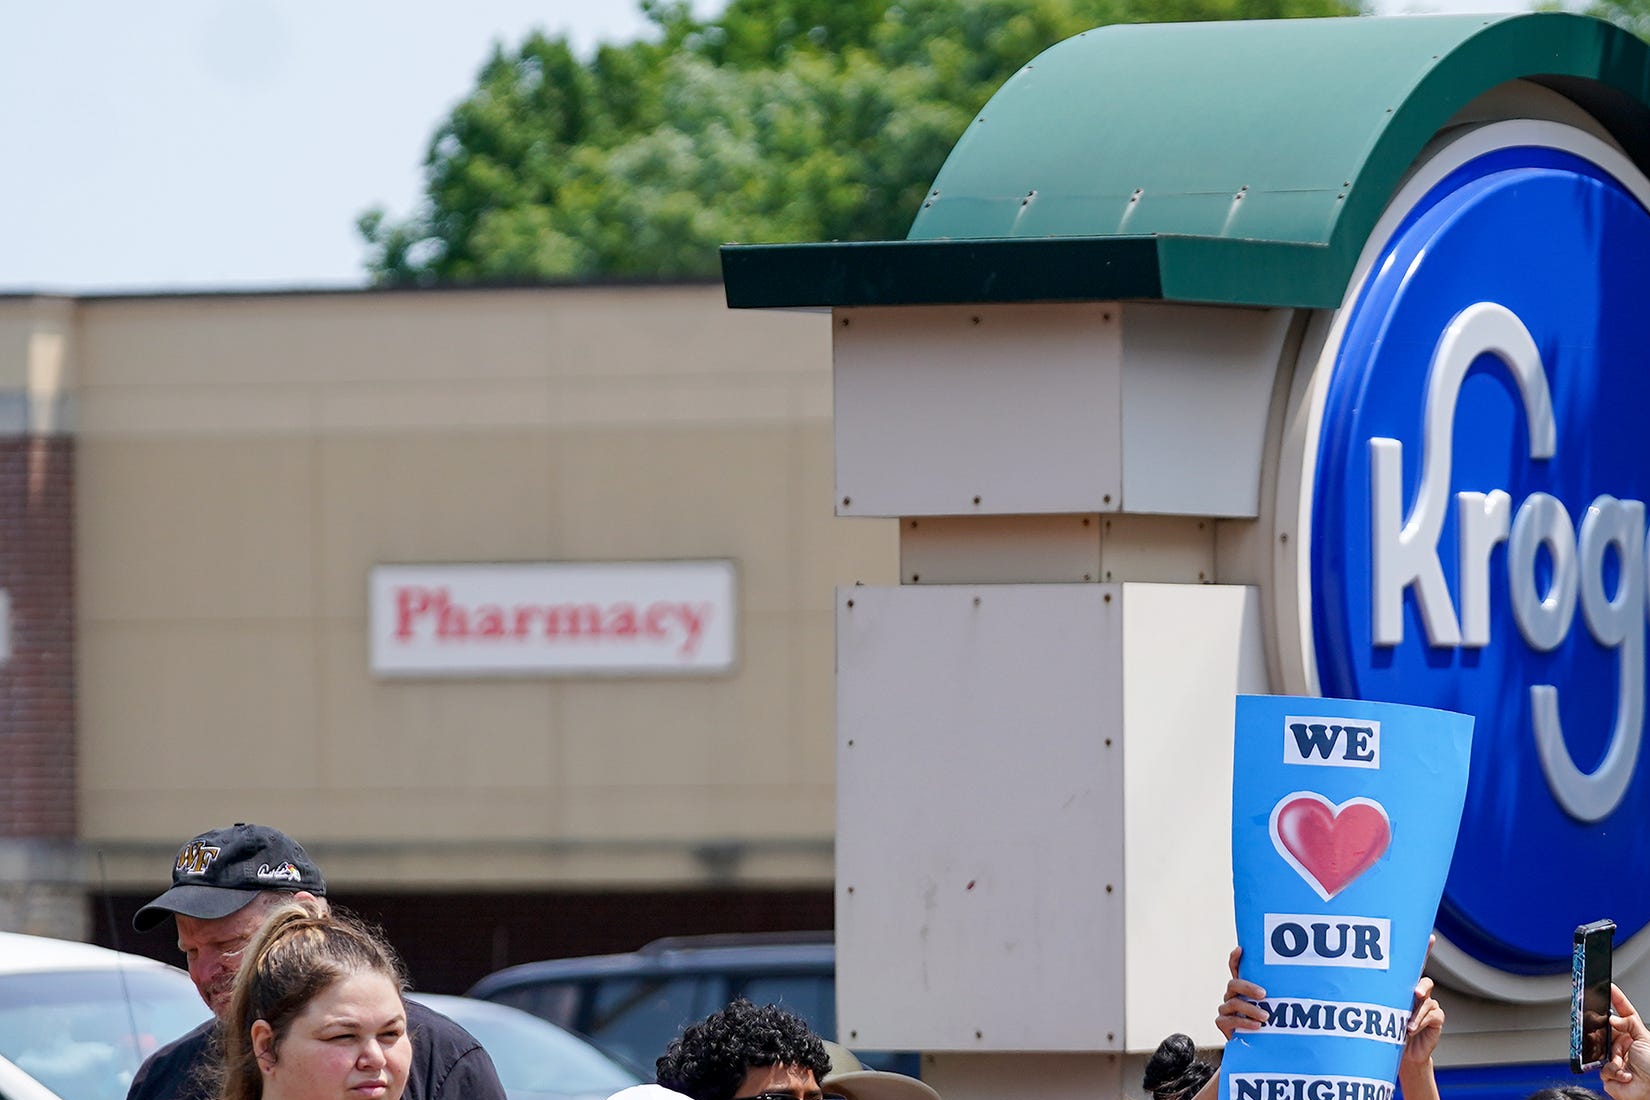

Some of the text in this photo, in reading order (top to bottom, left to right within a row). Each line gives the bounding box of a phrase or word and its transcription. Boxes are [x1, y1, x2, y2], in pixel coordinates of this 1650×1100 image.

[392, 585, 712, 664] Pharmacy
[1290, 722, 1375, 763] WE
[1270, 922, 1384, 962] OUR
[1249, 1001, 1408, 1041] MMIGRAN
